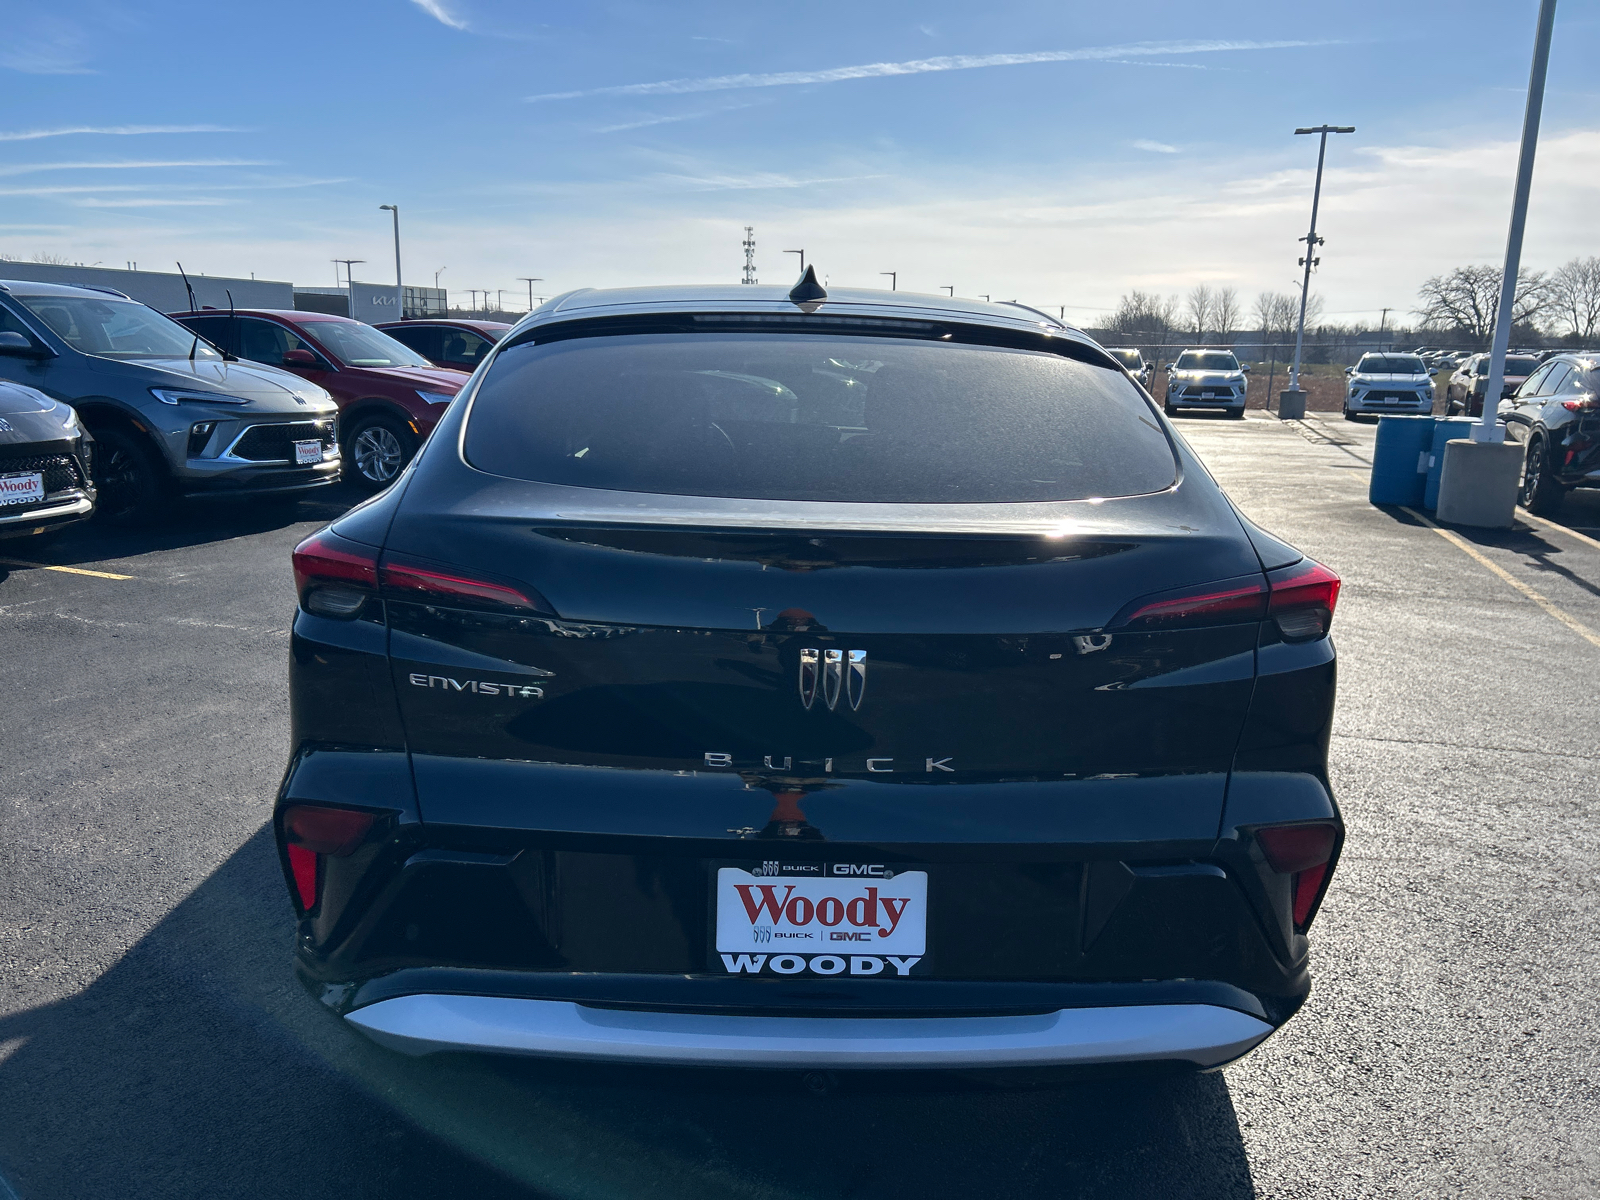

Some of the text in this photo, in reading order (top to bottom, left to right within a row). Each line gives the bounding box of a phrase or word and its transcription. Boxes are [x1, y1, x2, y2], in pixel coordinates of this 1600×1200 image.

[298, 446, 320, 456] Woody
[0, 478, 39, 492] Woody
[409, 673, 544, 699] ENVISTA
[704, 752, 955, 773] BUICK
[782, 863, 885, 876] BUICK GMC
[733, 884, 911, 938] Woody
[829, 931, 872, 942] GMC
[720, 954, 922, 976] WOODY
